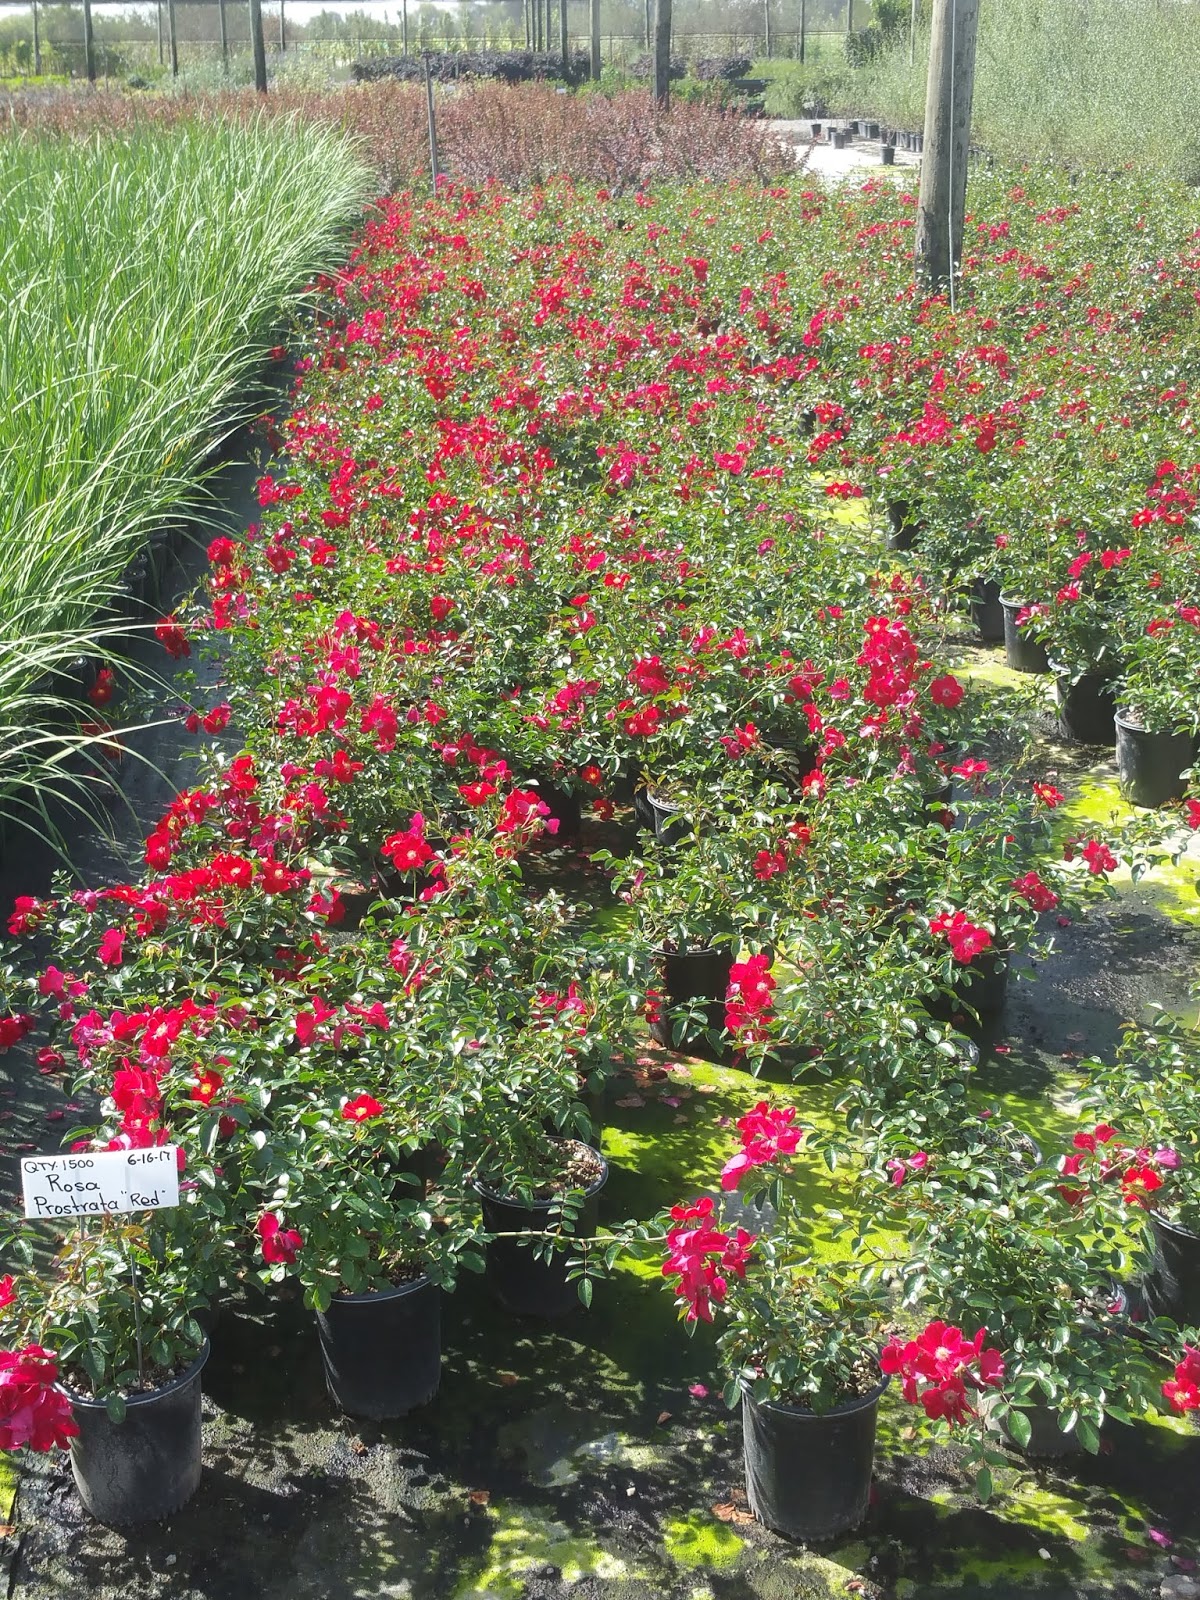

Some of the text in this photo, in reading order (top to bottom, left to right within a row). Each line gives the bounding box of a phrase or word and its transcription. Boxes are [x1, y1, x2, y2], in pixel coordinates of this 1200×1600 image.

[63, 1159, 94, 1171] 1500
[127, 1150, 171, 1165] 6-16-17
[45, 1174, 100, 1192] Rosa
[34, 1193, 119, 1215] Prostrata
